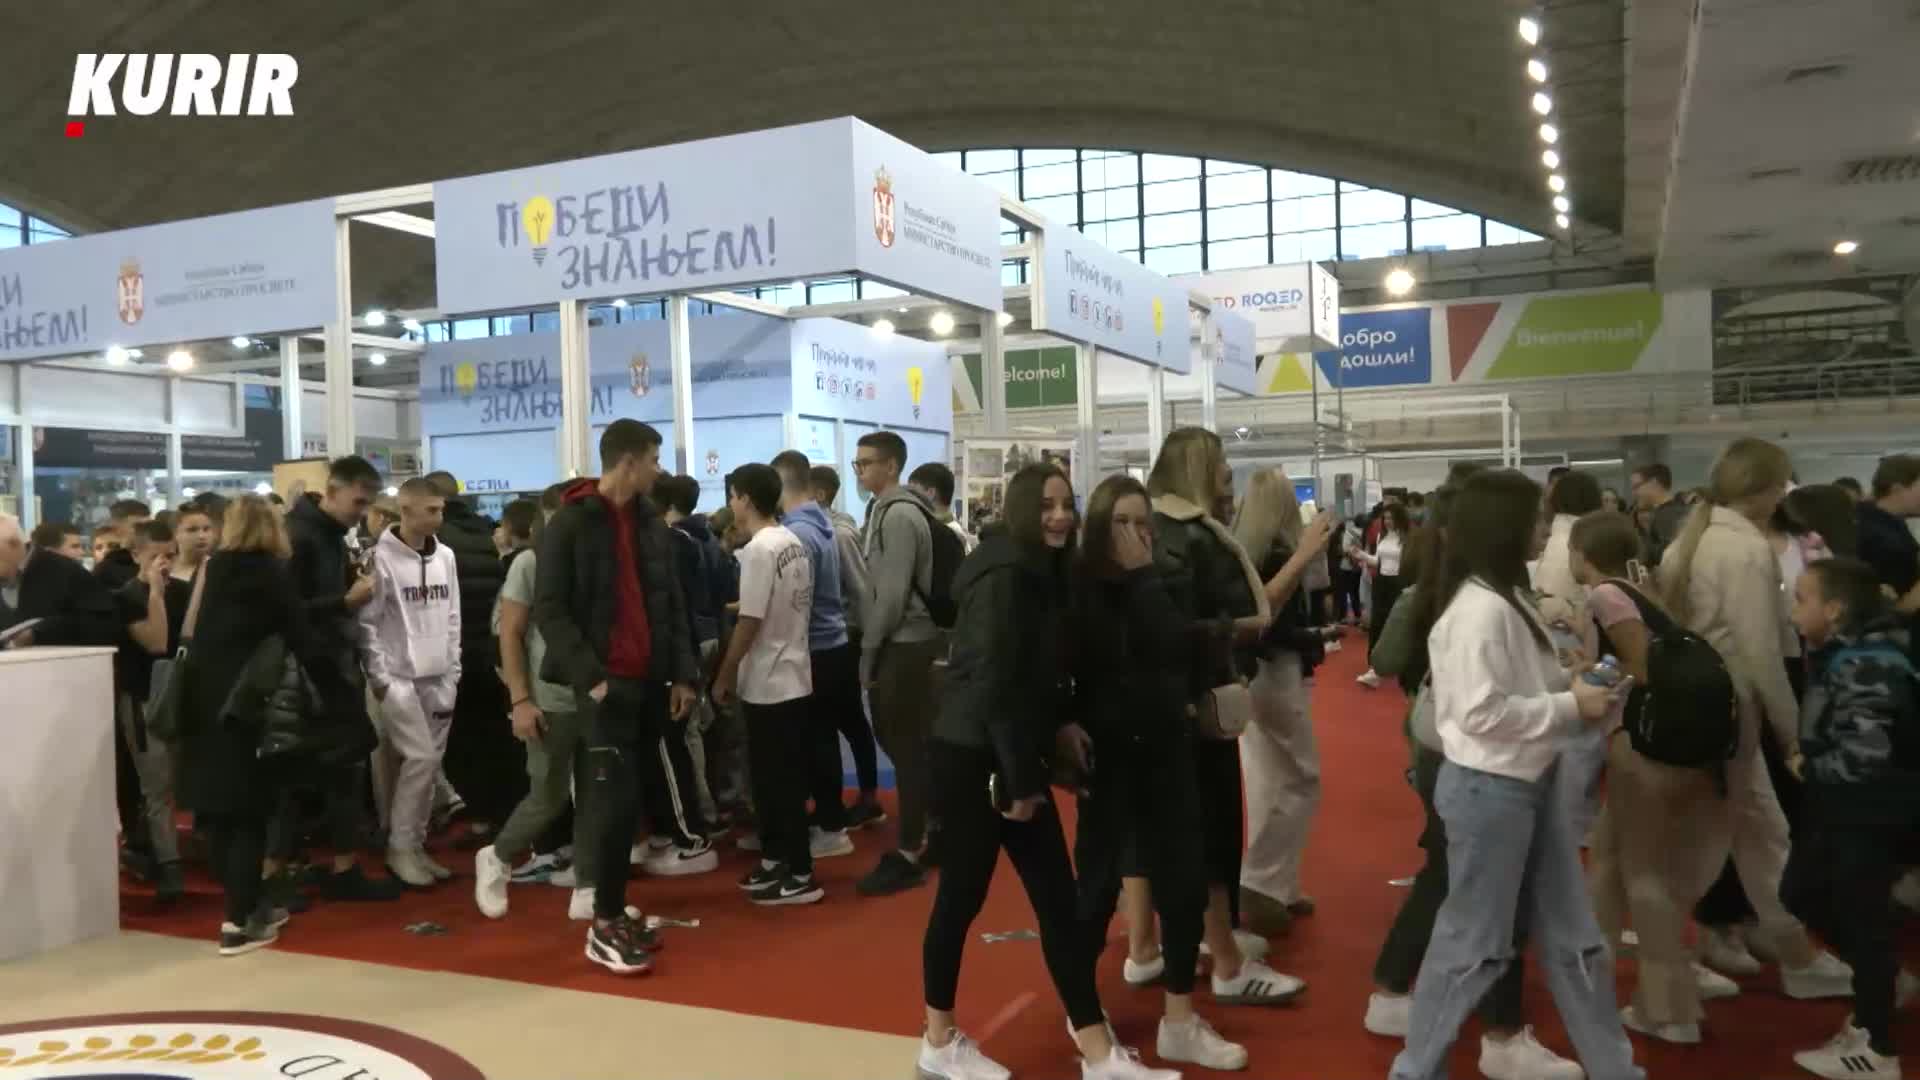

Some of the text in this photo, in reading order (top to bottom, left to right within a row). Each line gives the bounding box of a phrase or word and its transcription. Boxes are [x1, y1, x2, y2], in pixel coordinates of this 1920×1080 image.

[557, 216, 777, 290] ЗНАЊЕМ!
[0, 303, 88, 350] ЊЕМ!
[1341, 328, 1396, 349] обро
[1003, 363, 1066, 383] elcome!
